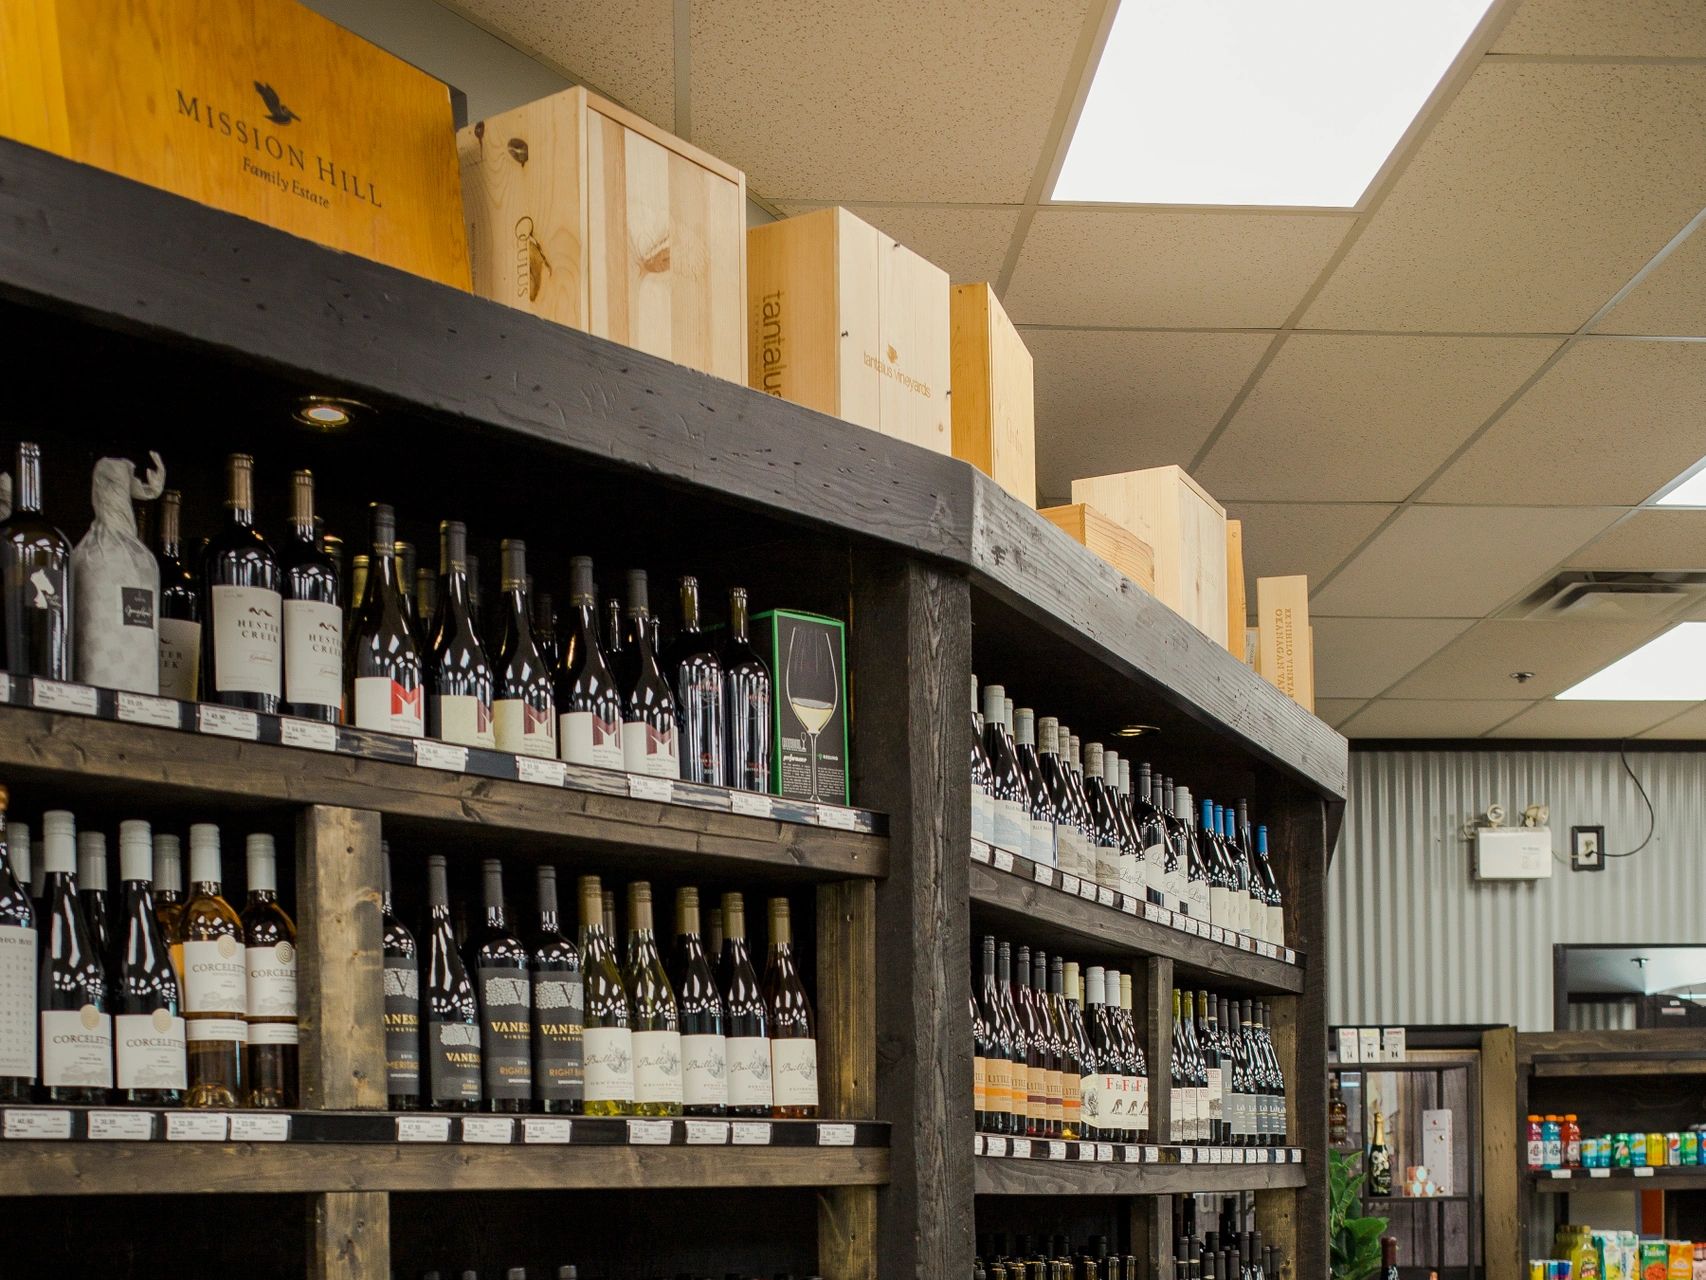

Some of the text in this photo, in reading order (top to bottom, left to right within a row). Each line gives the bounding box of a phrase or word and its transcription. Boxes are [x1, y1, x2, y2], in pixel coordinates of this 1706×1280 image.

[176, 88, 382, 208] MISSION HILL
[243, 156, 330, 208] Family Estate
[863, 351, 932, 399] tantalus vineyards
